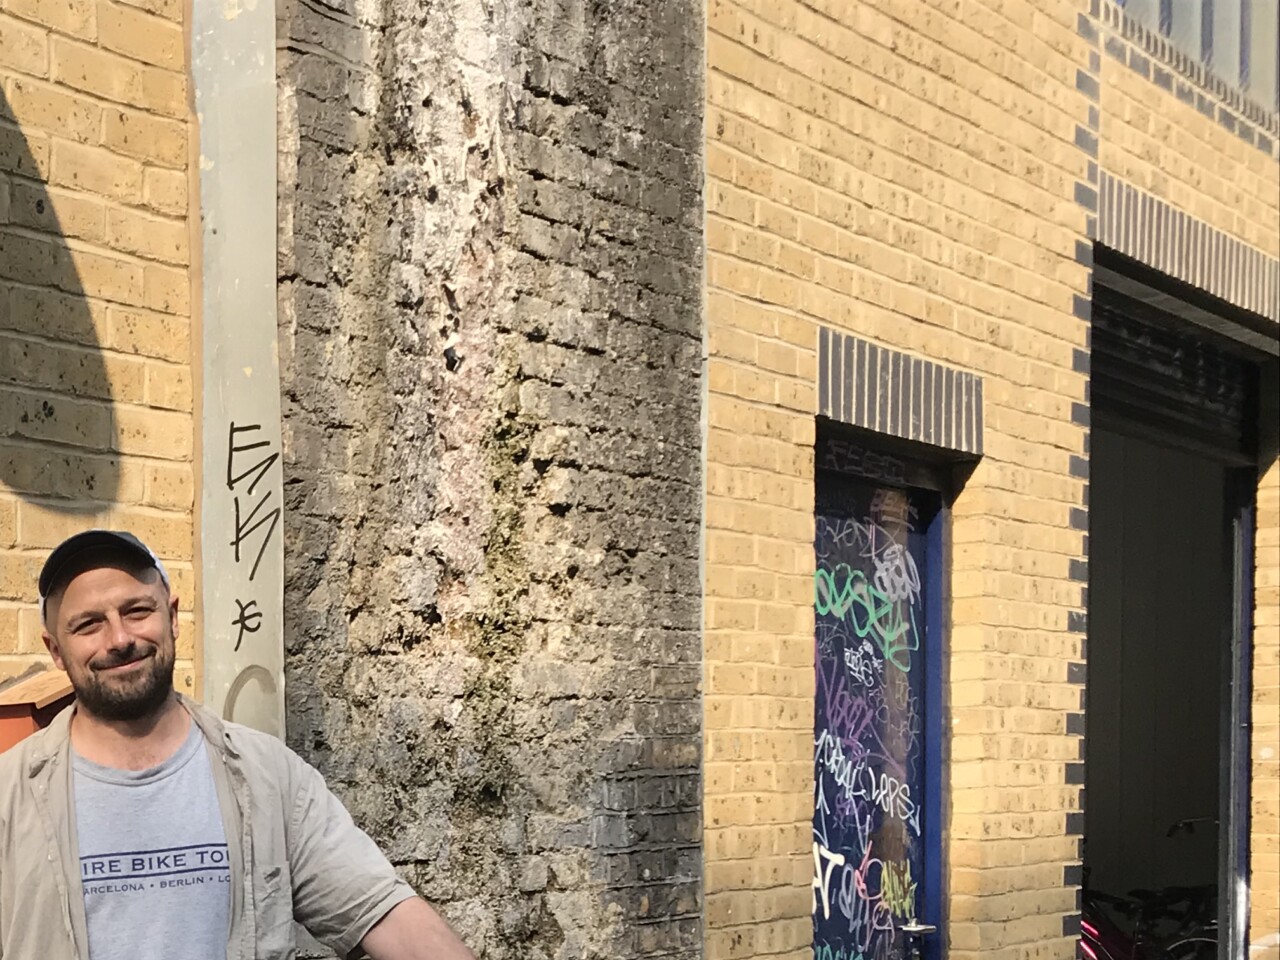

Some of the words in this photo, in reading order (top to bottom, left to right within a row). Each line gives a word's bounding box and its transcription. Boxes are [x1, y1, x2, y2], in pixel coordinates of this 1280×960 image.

[82, 859, 122, 876] IRE
[131, 853, 187, 872] BIKE
[195, 849, 230, 864] TO
[83, 883, 145, 896] ARCELONA
[159, 876, 205, 889] BERLIN
